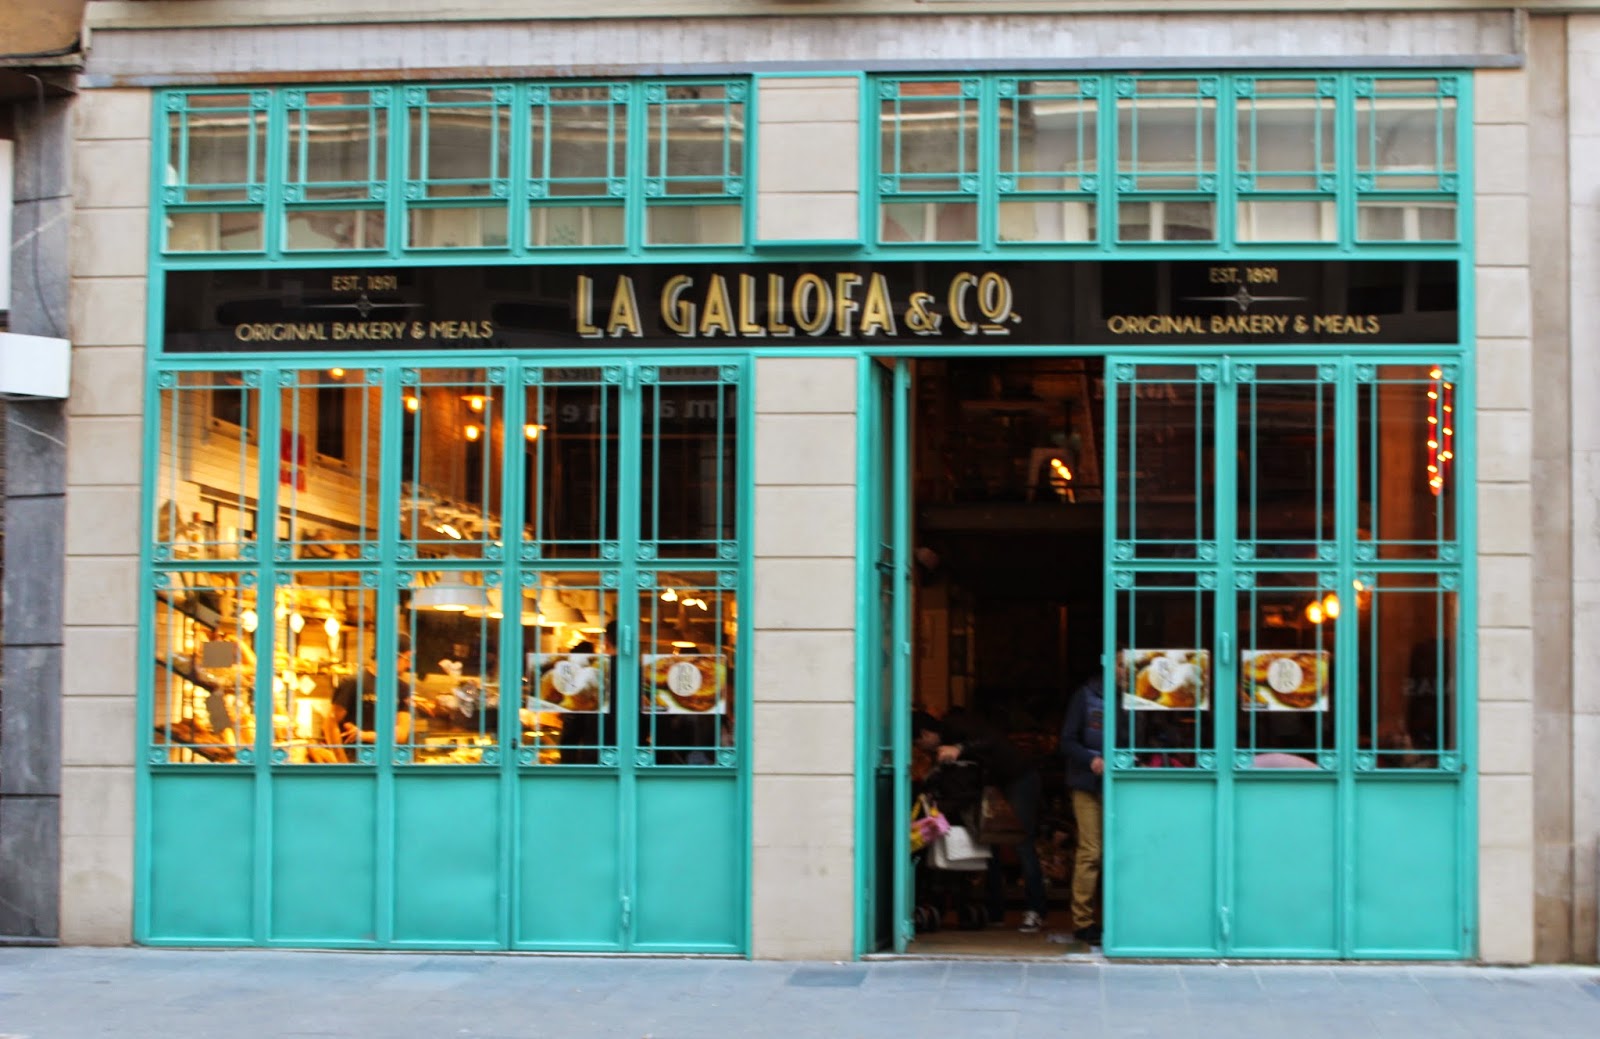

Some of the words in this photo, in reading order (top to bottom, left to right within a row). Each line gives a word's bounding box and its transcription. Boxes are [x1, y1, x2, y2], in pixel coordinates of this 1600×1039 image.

[332, 275, 363, 291] EST.
[367, 275, 398, 290] 1891
[1209, 267, 1242, 283] EST.
[1246, 267, 1278, 283] 1891
[576, 273, 644, 338] LA
[660, 272, 897, 338] GALLOFA
[904, 291, 942, 335] &
[235, 323, 327, 341] ORIGINAL
[332, 322, 404, 340] BAKERY
[410, 321, 425, 339] &
[429, 321, 493, 339] MEALS
[1107, 315, 1206, 334] ORIGINAL
[1210, 315, 1288, 334] BAKERY
[1294, 315, 1308, 333] &
[1314, 315, 1380, 334] MEALS
